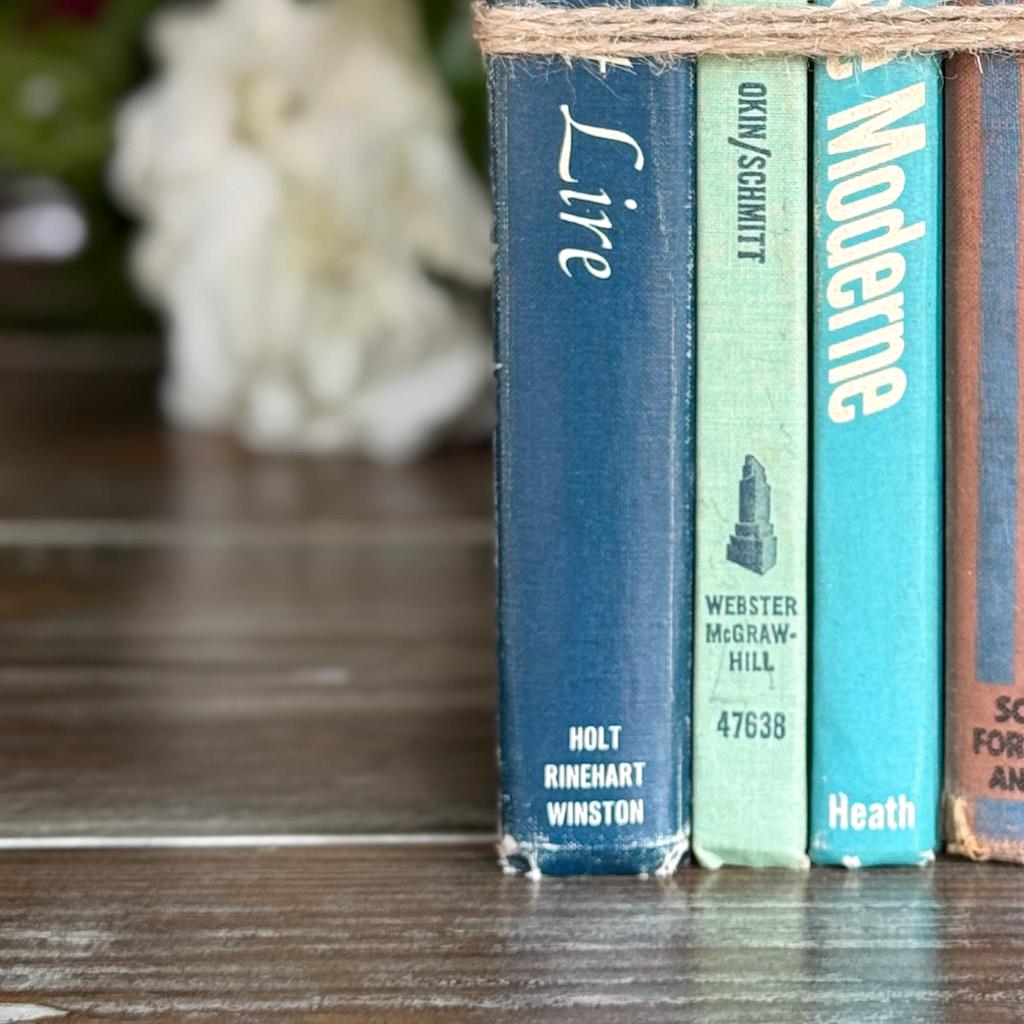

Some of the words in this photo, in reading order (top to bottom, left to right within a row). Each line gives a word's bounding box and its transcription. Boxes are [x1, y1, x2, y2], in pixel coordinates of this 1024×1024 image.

[727, 81, 772, 265] OKIN/SCHMITT
[558, 104, 645, 279] Lire
[825, 81, 927, 424] Moderne
[704, 594, 798, 616] WEBSTER
[705, 622, 797, 645] McGRAW-
[729, 650, 775, 673] HILL
[569, 725, 623, 752] HOLT
[716, 709, 786, 740] 47638
[544, 761, 647, 789] RINEHART
[546, 798, 645, 827] WINSTON
[828, 792, 917, 832] Heath
